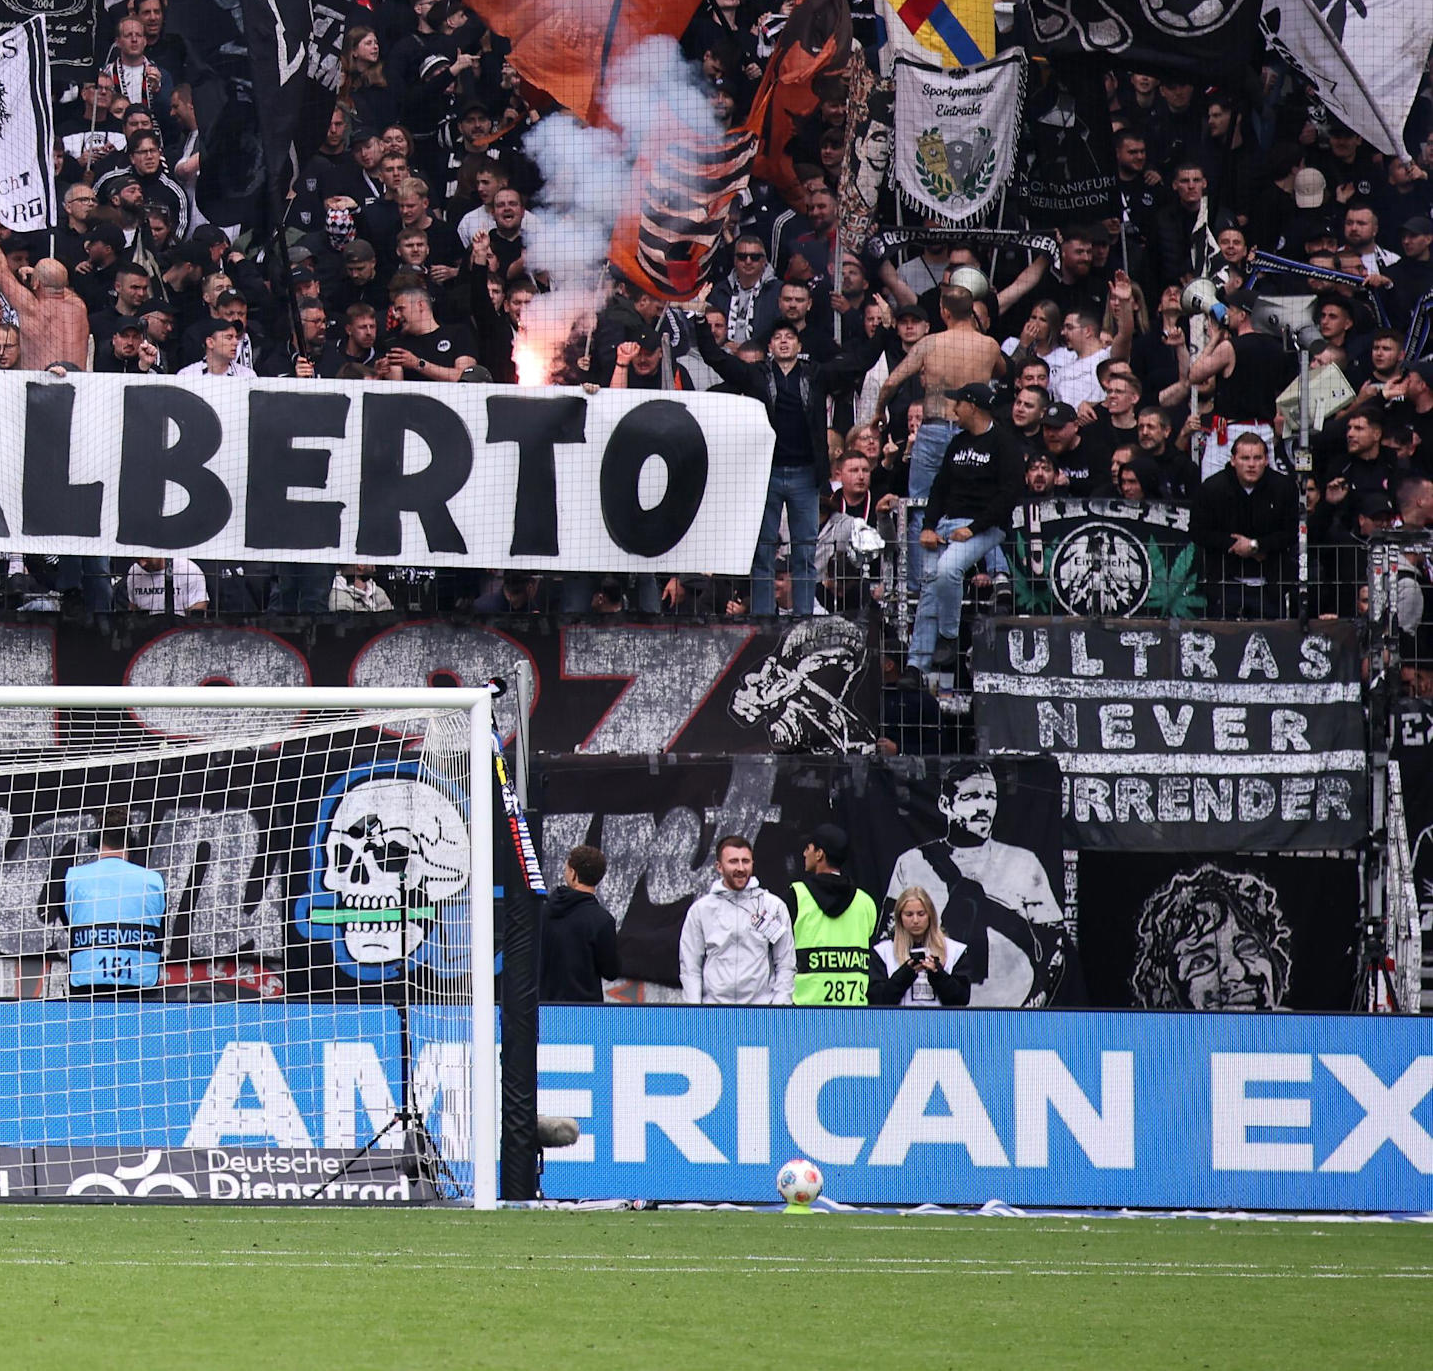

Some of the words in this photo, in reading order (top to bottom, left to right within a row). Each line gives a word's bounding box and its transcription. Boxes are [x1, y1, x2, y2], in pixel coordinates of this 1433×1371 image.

[32, 0, 56, 10] 2004
[935, 102, 983, 118] Eintracht
[1007, 628, 1333, 680] ULTRAS
[1036, 700, 1312, 752] NEVER
[1062, 776, 1354, 824] RRENDER
[73, 928, 157, 949] SUPERVISOR
[98, 956, 134, 981] 151
[206, 1149, 340, 1175] Deutsche
[209, 1172, 411, 1202] Dienstrad
